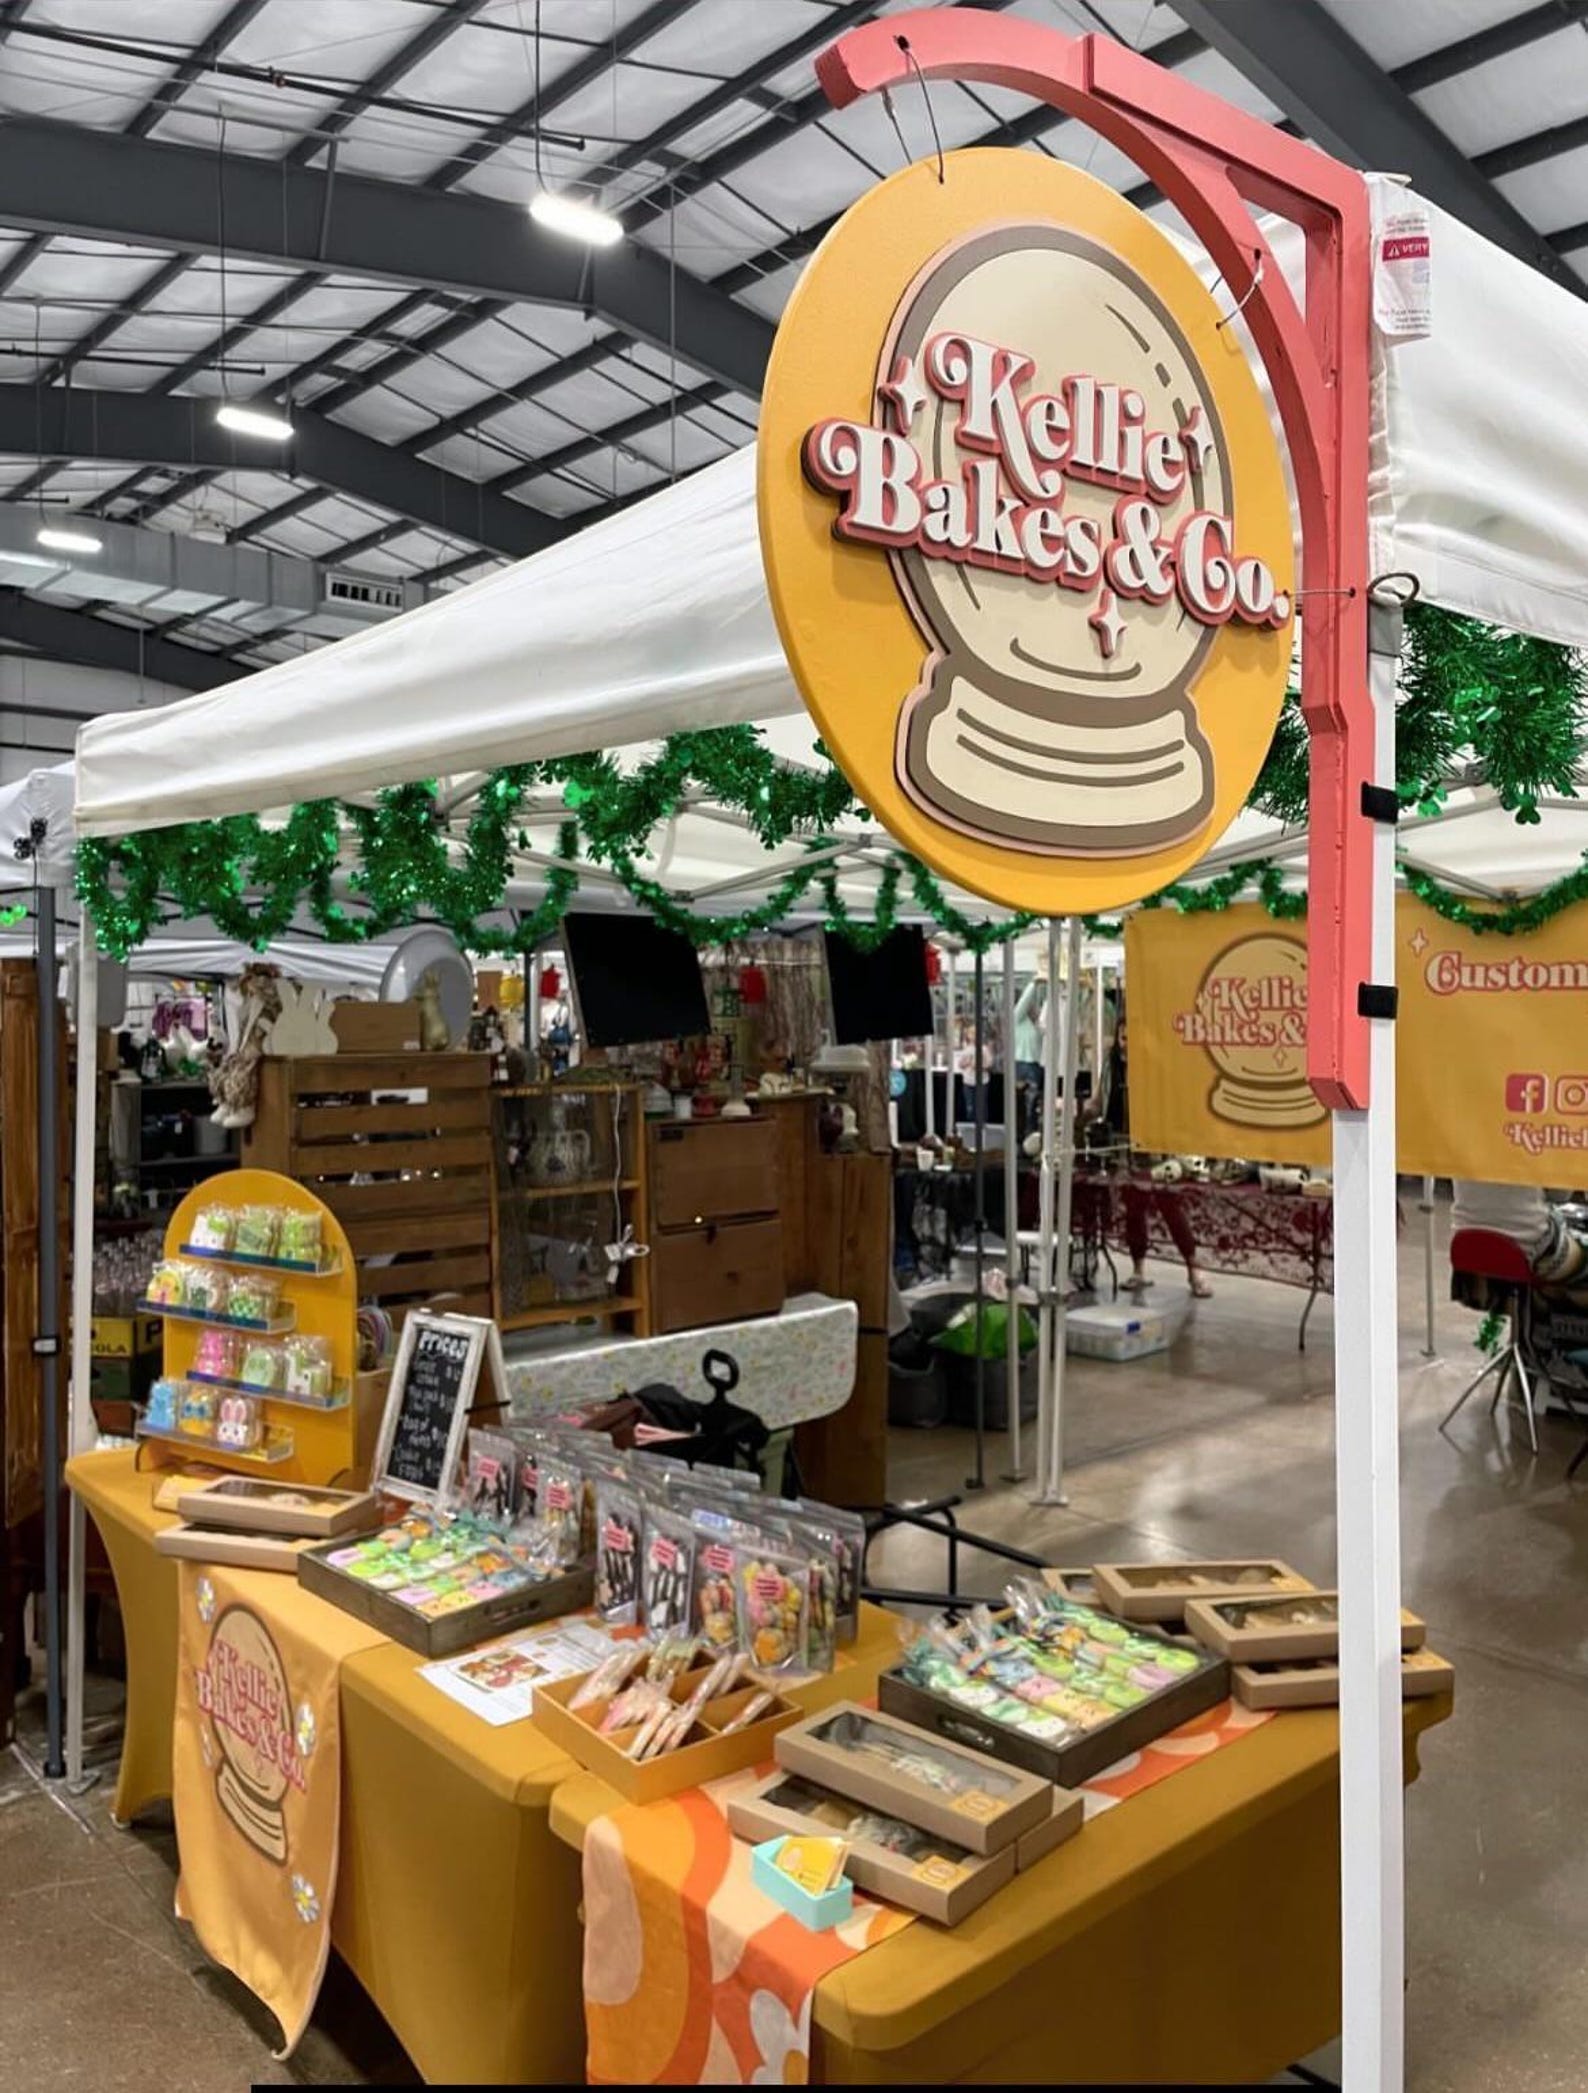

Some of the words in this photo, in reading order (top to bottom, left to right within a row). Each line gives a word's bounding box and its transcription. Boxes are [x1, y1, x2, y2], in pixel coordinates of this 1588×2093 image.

[928, 334, 1186, 502] Kellie
[810, 420, 1100, 585] Bakes
[1107, 500, 1175, 602] &
[1178, 513, 1291, 624] Co.
[1173, 1013, 1277, 1046] Bakes
[1503, 1122, 1588, 1156] Kellie
[92, 1343, 127, 1354] OLA
